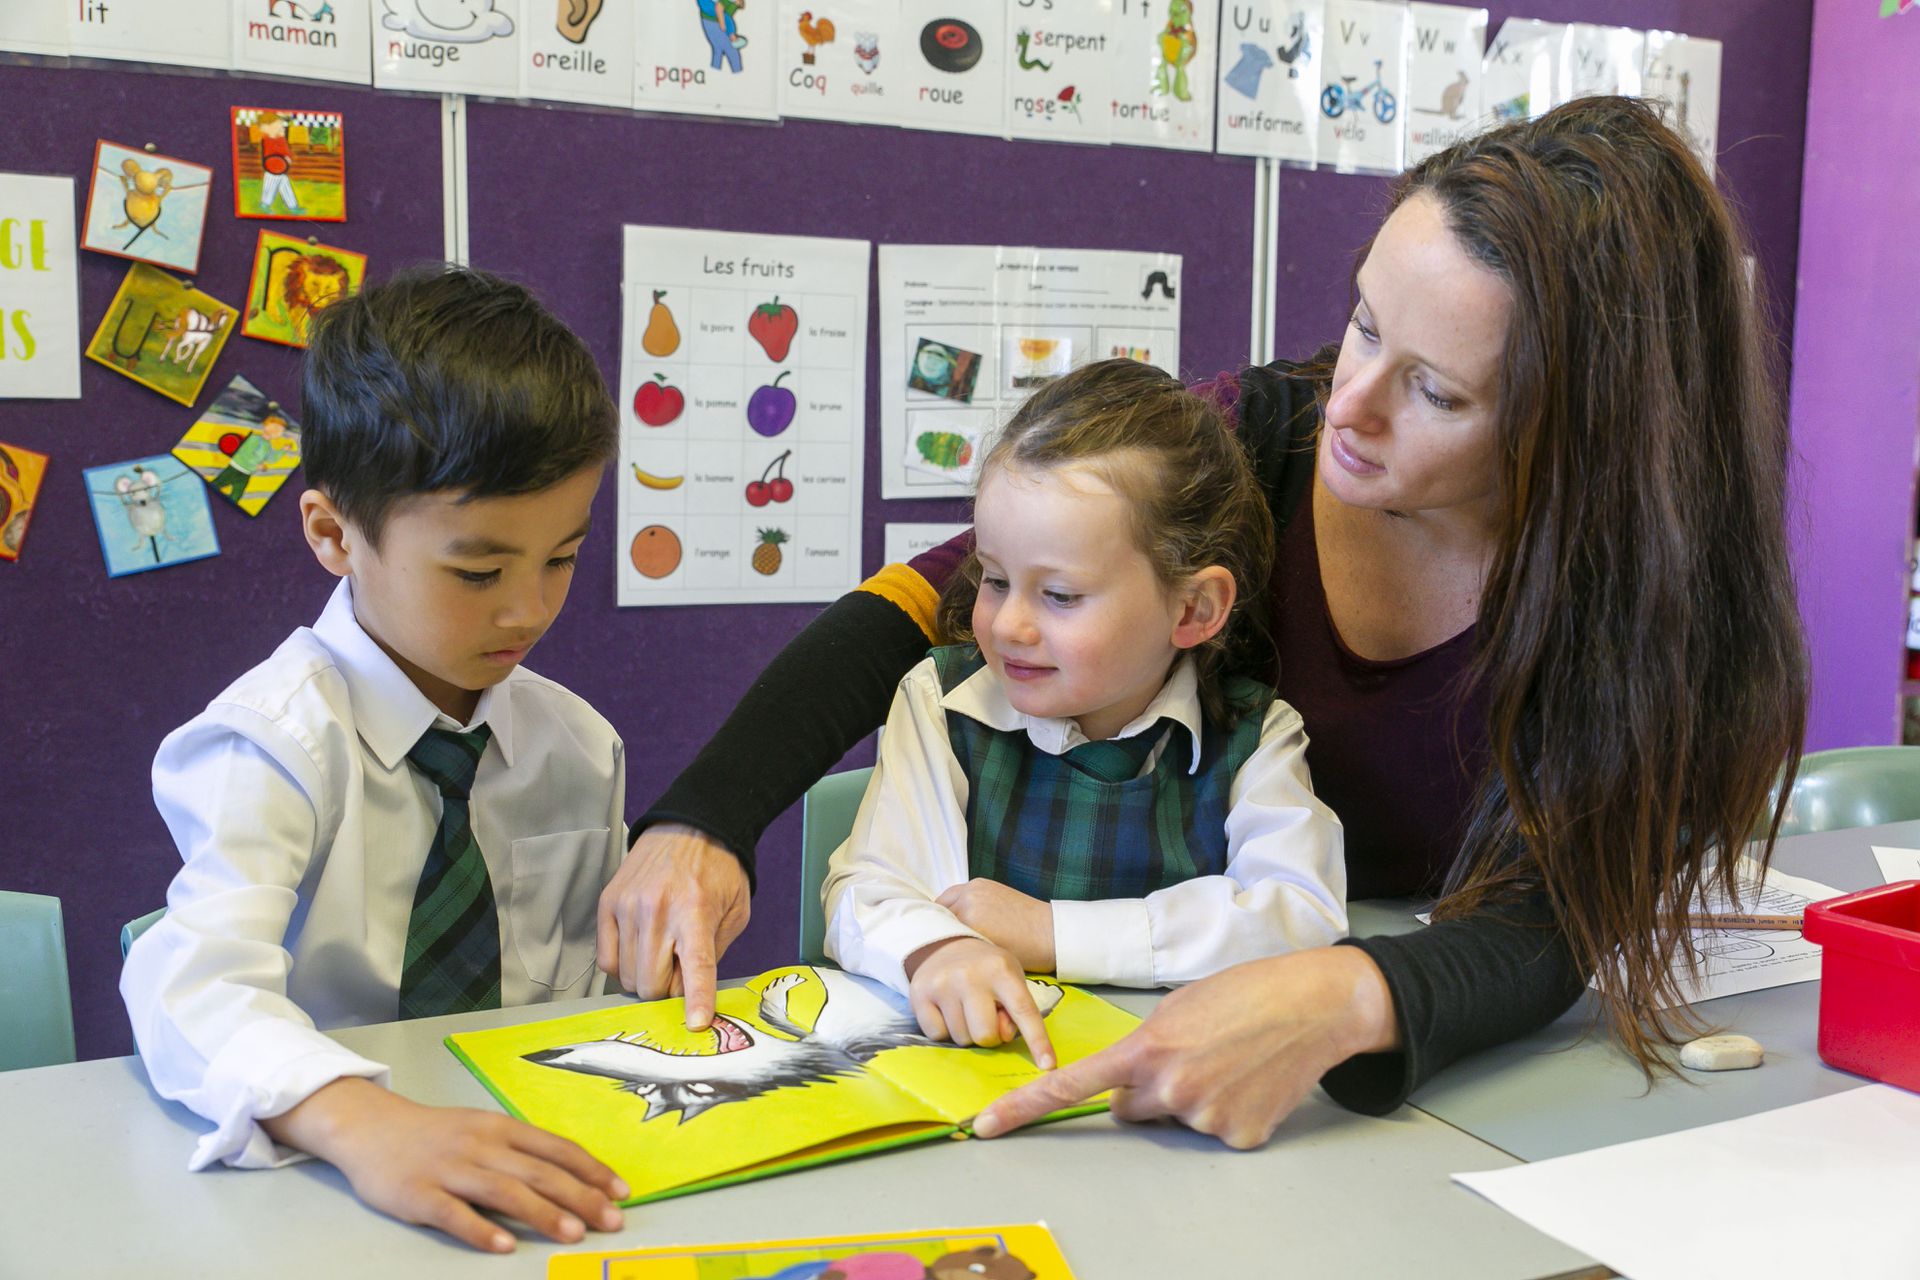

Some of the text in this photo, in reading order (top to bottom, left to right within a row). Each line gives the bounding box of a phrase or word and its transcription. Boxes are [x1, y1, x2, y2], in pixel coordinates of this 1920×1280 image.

[79, 0, 109, 24] lit
[249, 21, 337, 48] maman
[1034, 30, 1107, 54] serpent
[388, 38, 460, 67] nuage
[532, 50, 607, 74] oreille
[655, 64, 706, 89] papa
[789, 67, 827, 96] Coq
[850, 80, 884, 97] quille
[918, 86, 964, 104] roue
[1014, 97, 1056, 114] rose
[1111, 100, 1170, 121] tortue
[1228, 111, 1304, 135] uniforme
[703, 255, 795, 278] Les fruits
